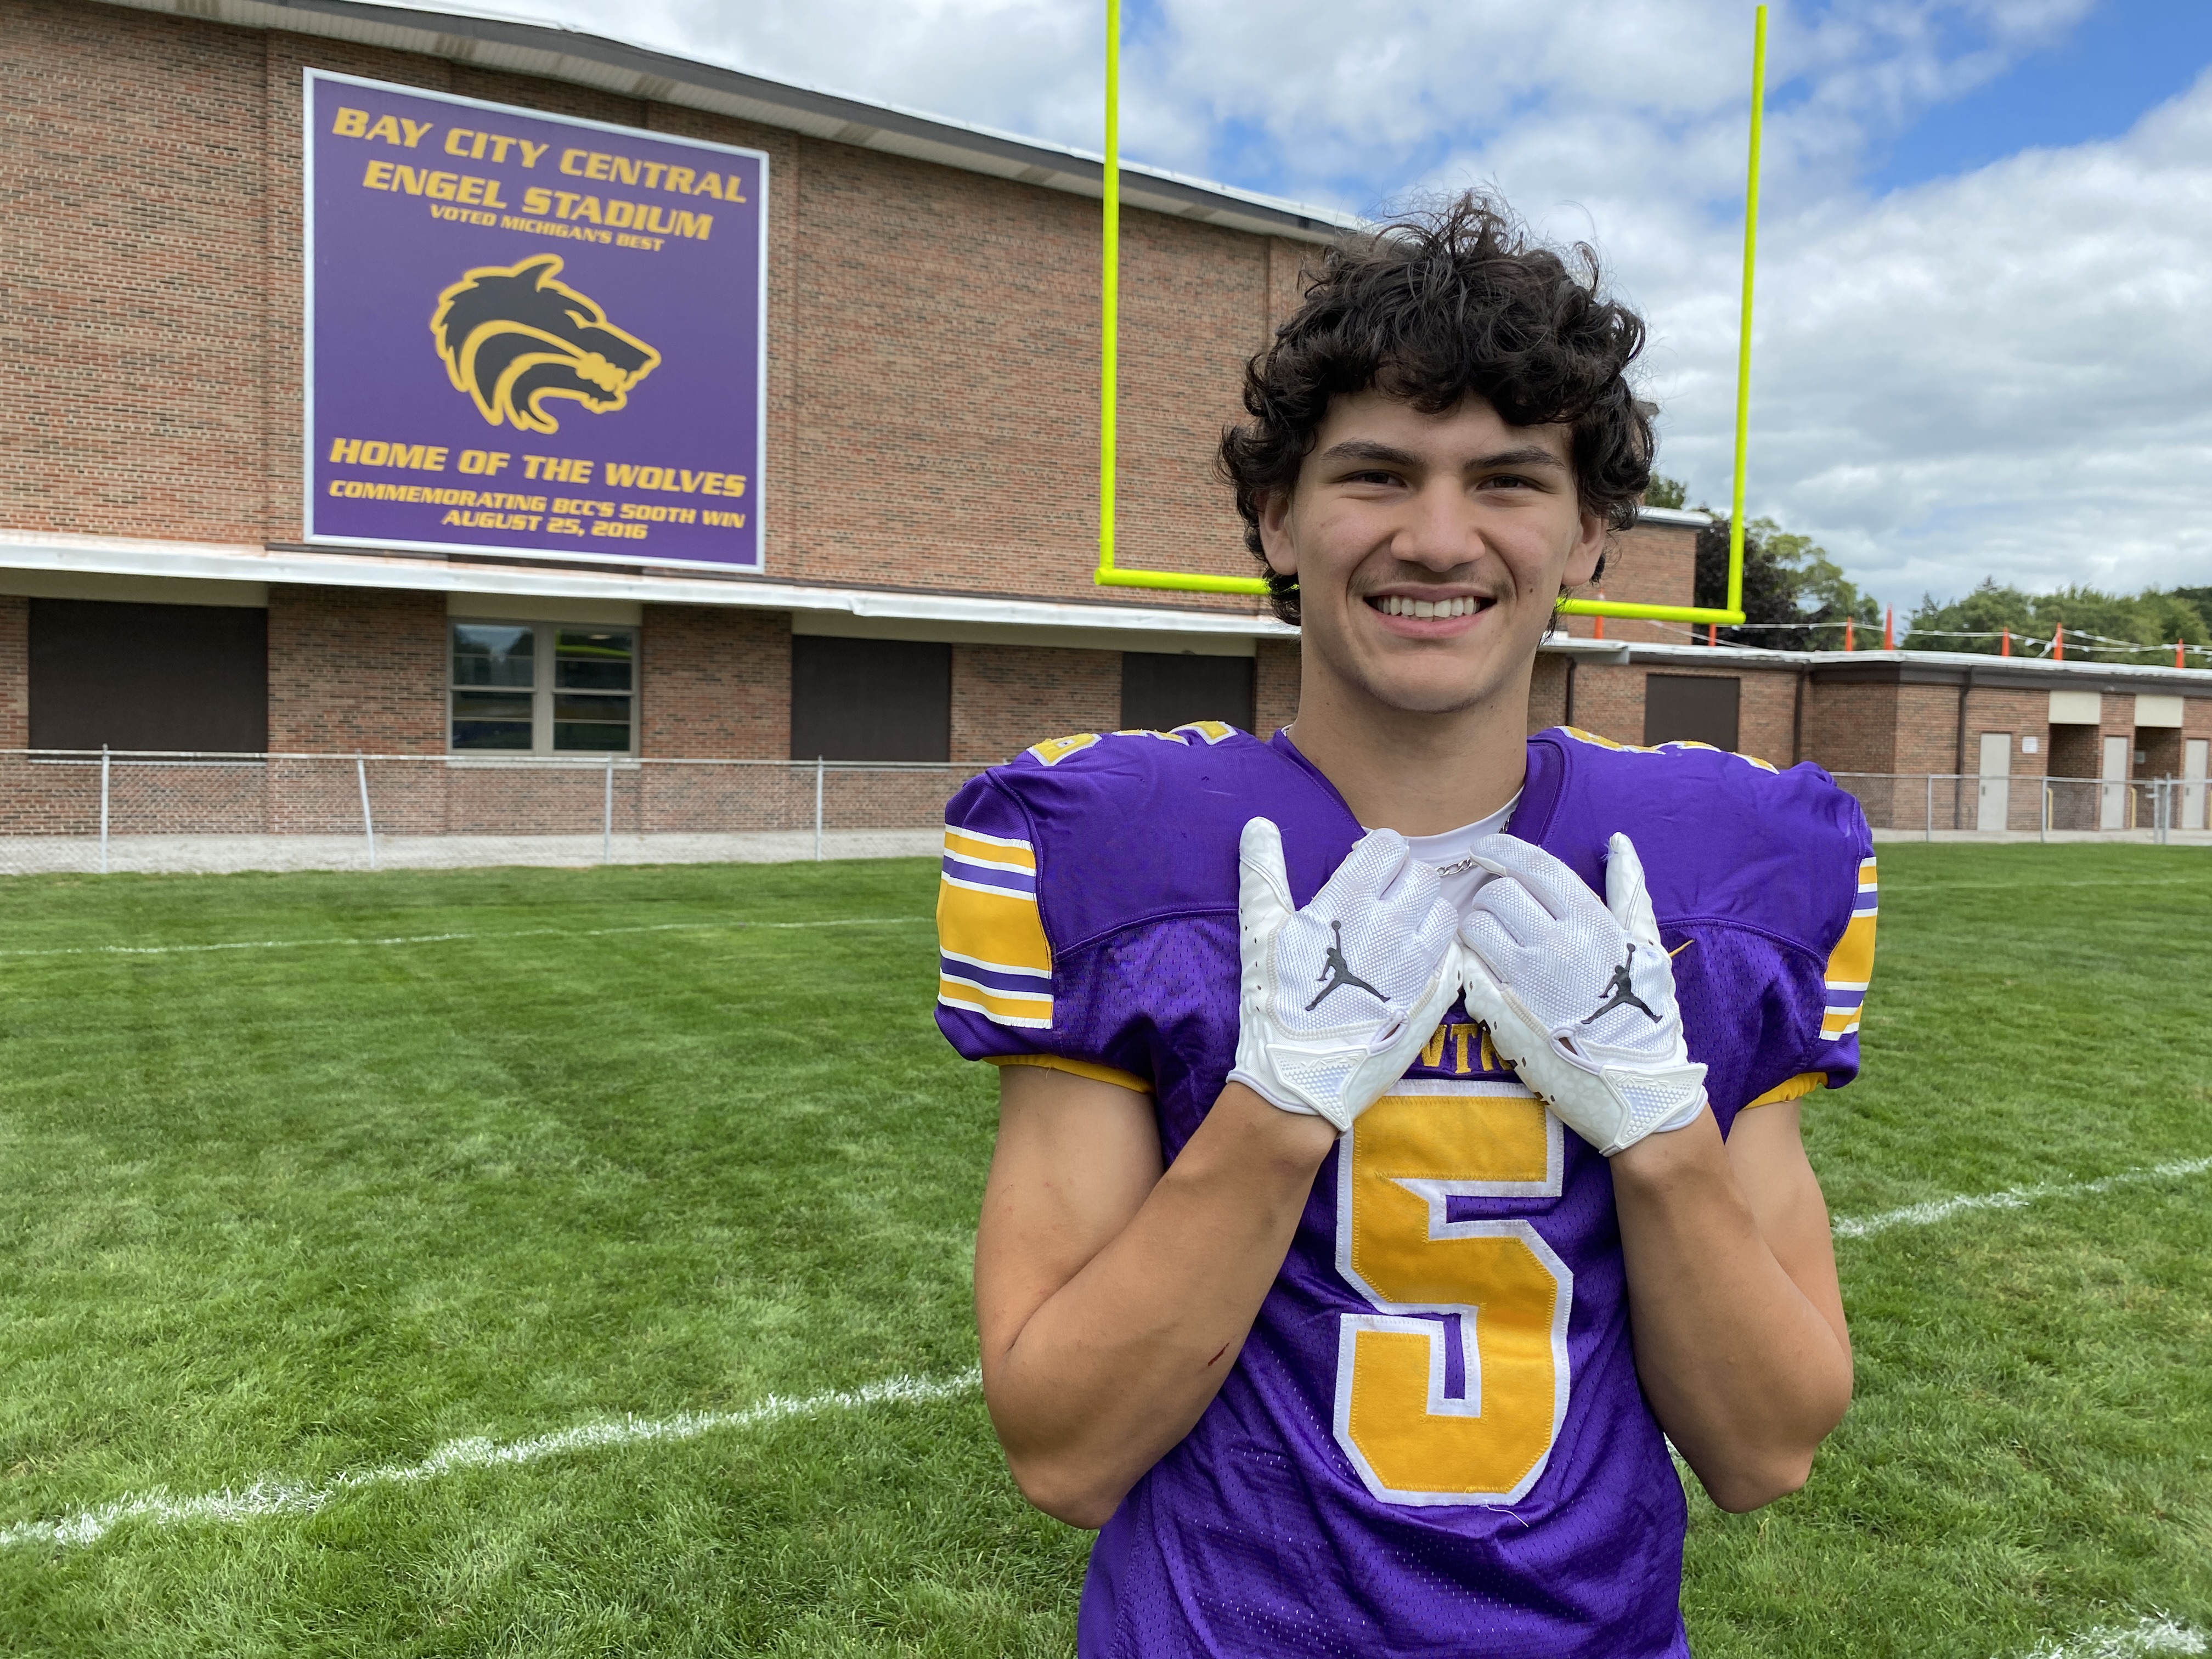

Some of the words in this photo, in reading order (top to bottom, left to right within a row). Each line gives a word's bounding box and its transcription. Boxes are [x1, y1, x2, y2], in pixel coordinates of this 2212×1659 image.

[333, 107, 432, 147] BAY
[444, 128, 548, 168] CITY
[560, 149, 746, 202] CENTRAL
[363, 161, 506, 208] ENGEL
[523, 187, 713, 240] STADIUM
[431, 204, 496, 225] VOTED
[501, 216, 611, 243] MICHIGAN'S
[616, 233, 663, 251] BEST
[330, 438, 448, 471] HOME
[458, 450, 510, 475] OF
[524, 455, 593, 483] THE
[606, 463, 746, 496] WOLVES
[329, 481, 546, 511] COMMEMORATING
[552, 498, 614, 517] BCC'S
[620, 504, 696, 523] 500TH
[703, 511, 744, 528] WIN
[443, 510, 542, 531] AUGUST
[547, 517, 584, 536] 25,
[591, 521, 647, 539] 2016
[1333, 1079, 1573, 1506] 5
